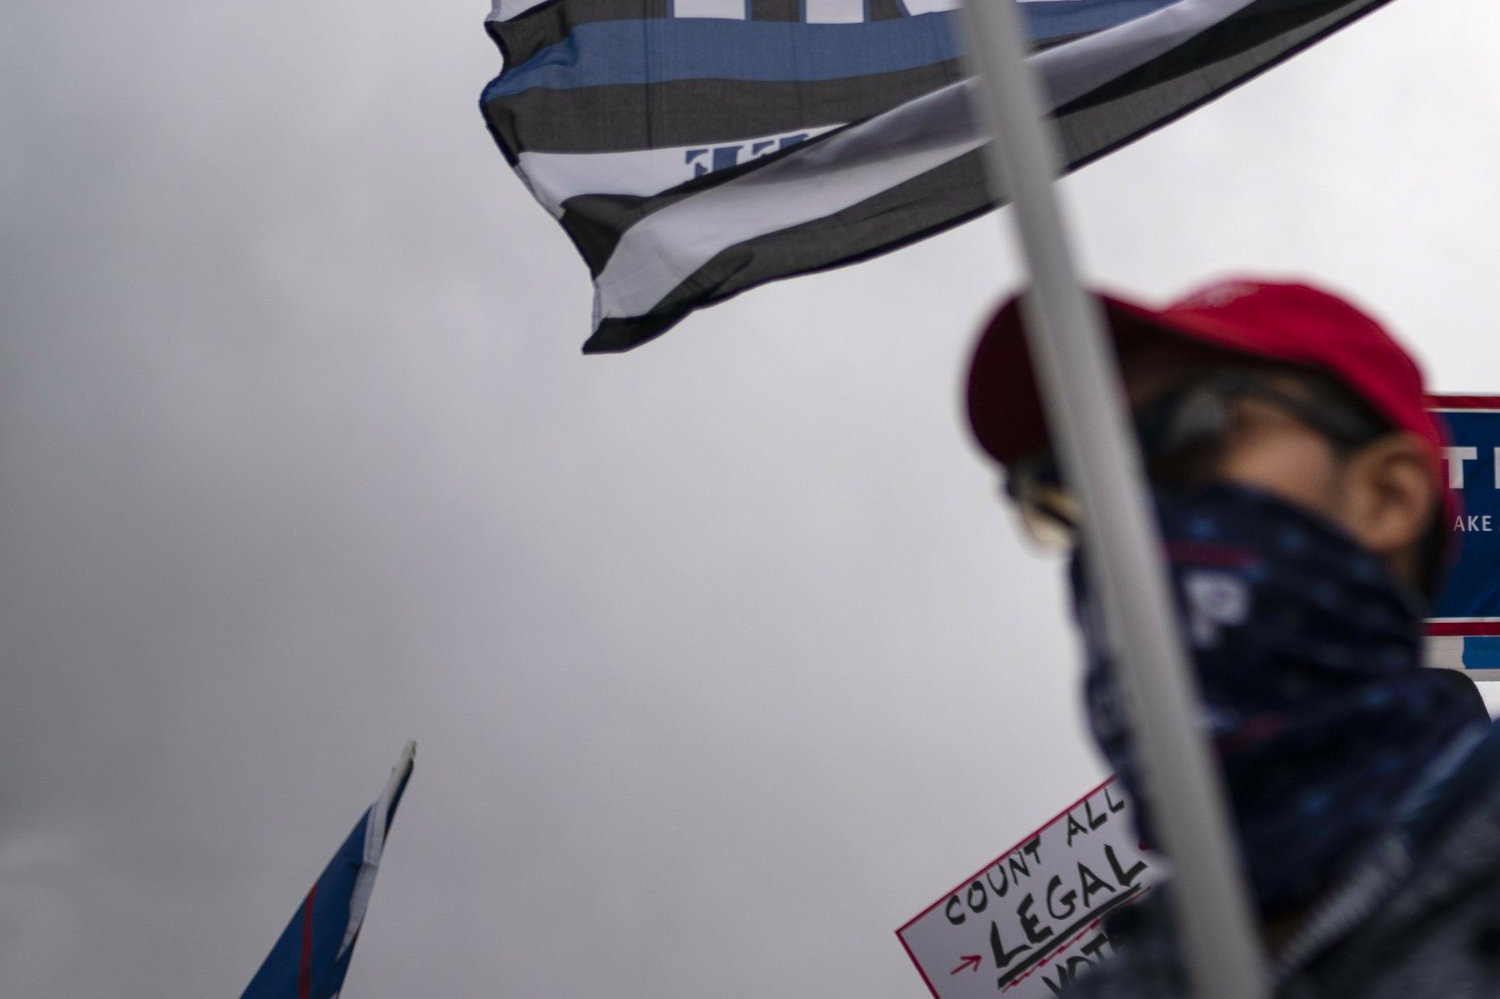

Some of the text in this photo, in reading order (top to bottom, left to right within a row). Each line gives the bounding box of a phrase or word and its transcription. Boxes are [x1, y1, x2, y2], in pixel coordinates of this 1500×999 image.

[1453, 514, 1493, 533] AKE
[944, 788, 1125, 926] COUNT ALL
[990, 844, 1149, 969] LEGAL
